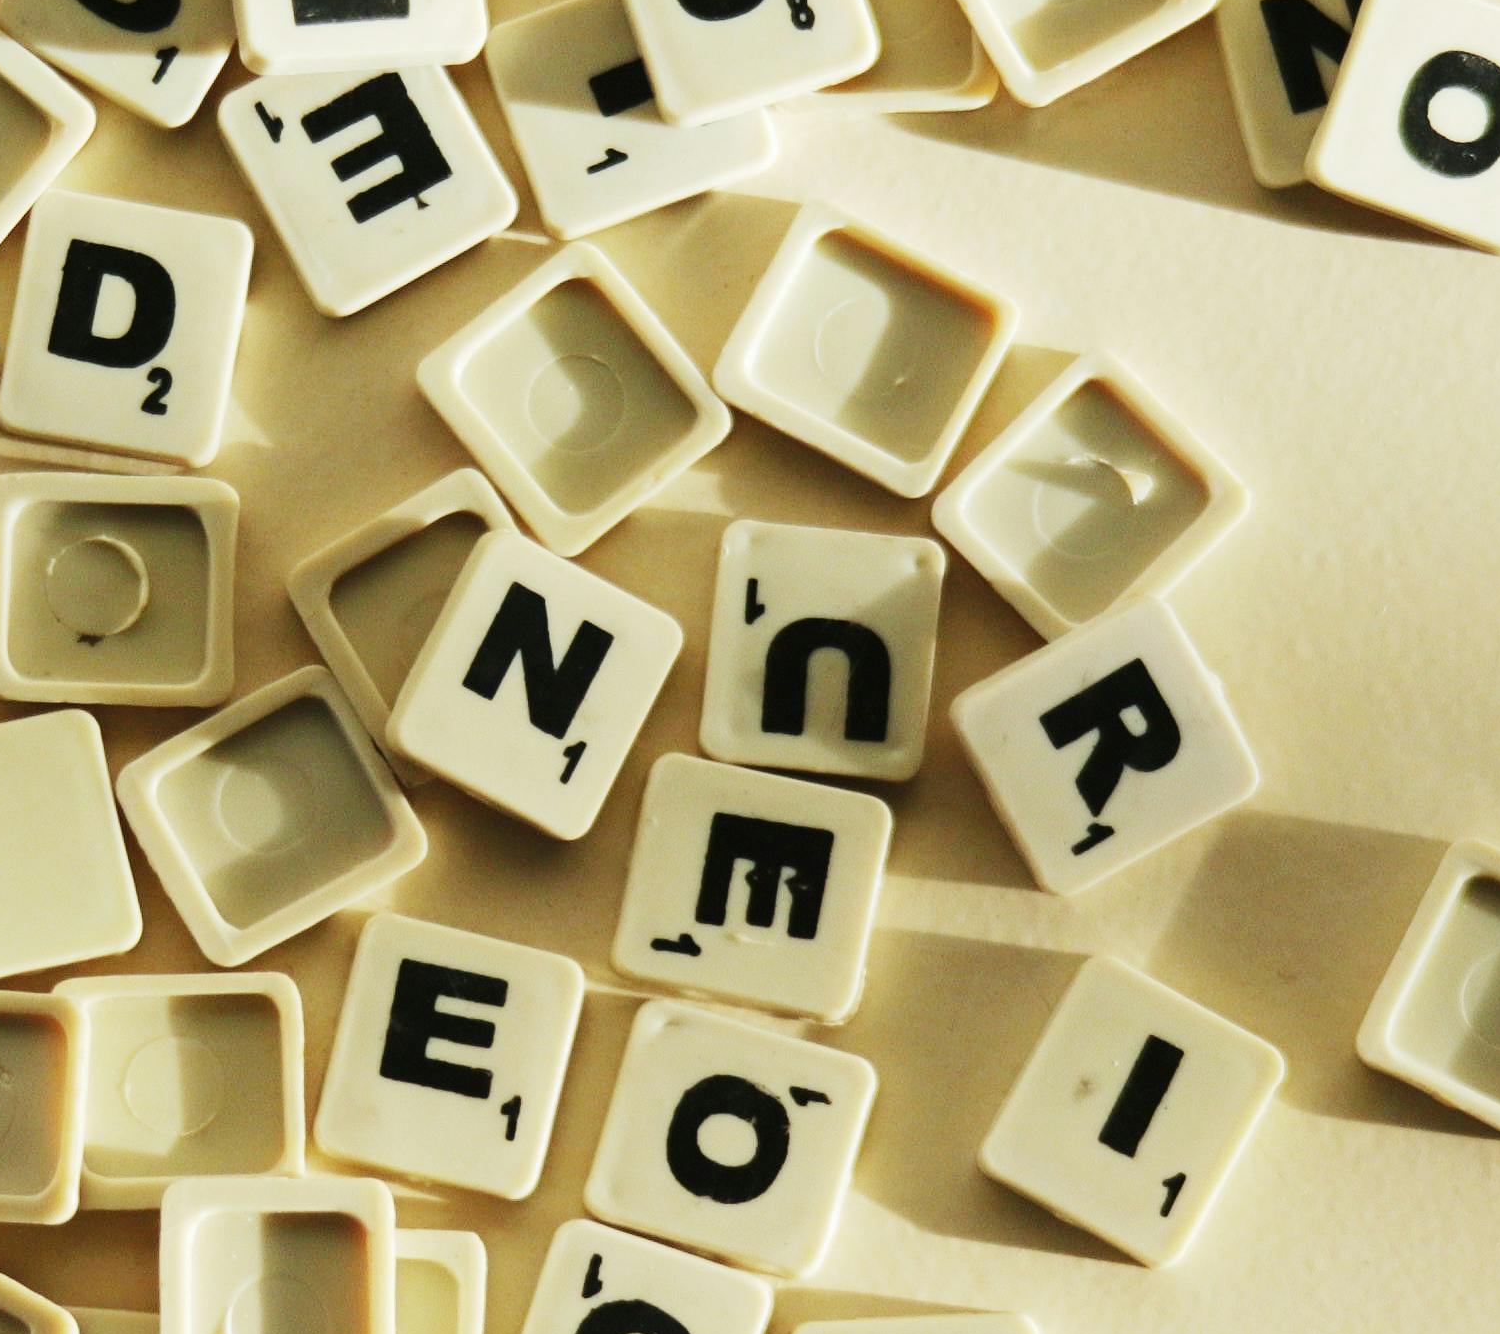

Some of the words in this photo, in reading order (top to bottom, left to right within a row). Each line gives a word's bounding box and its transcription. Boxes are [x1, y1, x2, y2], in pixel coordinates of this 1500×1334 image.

[152, 44, 180, 84] 1
[255, 102, 283, 143] 1
[301, 72, 452, 223] E
[587, 148, 628, 174] 1
[48, 239, 176, 368] D
[141, 367, 172, 415] 2
[745, 578, 765, 625] 1
[462, 582, 614, 739] N
[560, 741, 587, 784] 1
[761, 618, 892, 743] U
[1039, 658, 1181, 818] R
[695, 812, 834, 939] E
[1072, 823, 1115, 855] 1
[650, 934, 701, 957] 1
[380, 958, 508, 1099] E
[501, 1096, 521, 1141] 1
[666, 1075, 790, 1204] O
[789, 1086, 831, 1106] 1
[1099, 1035, 1184, 1158] I
[1160, 1173, 1186, 1217] 1
[582, 1254, 602, 1298] 1
